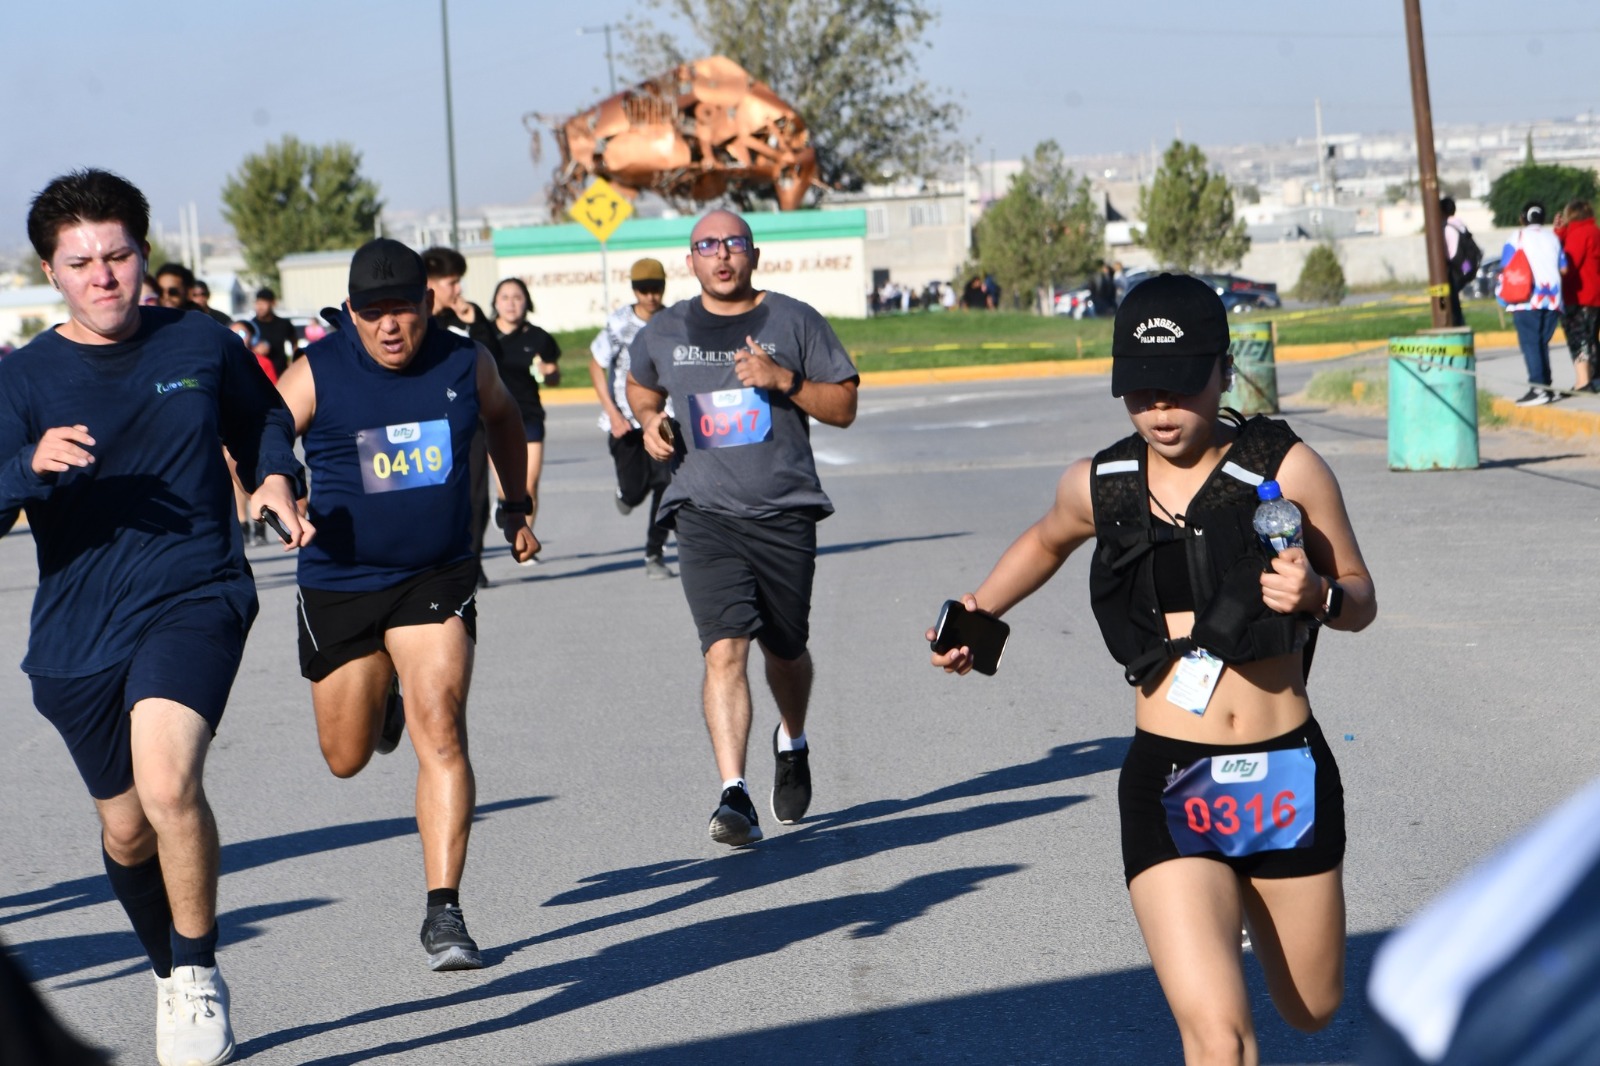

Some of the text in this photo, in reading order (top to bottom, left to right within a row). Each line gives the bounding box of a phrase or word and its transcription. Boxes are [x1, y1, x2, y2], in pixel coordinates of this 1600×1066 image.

[1132, 317, 1185, 340] LOS ANGELES
[1140, 335, 1176, 344] PALM BEACH
[700, 409, 760, 438] 0317
[373, 445, 443, 479] 0419
[1184, 789, 1297, 835] 0316
